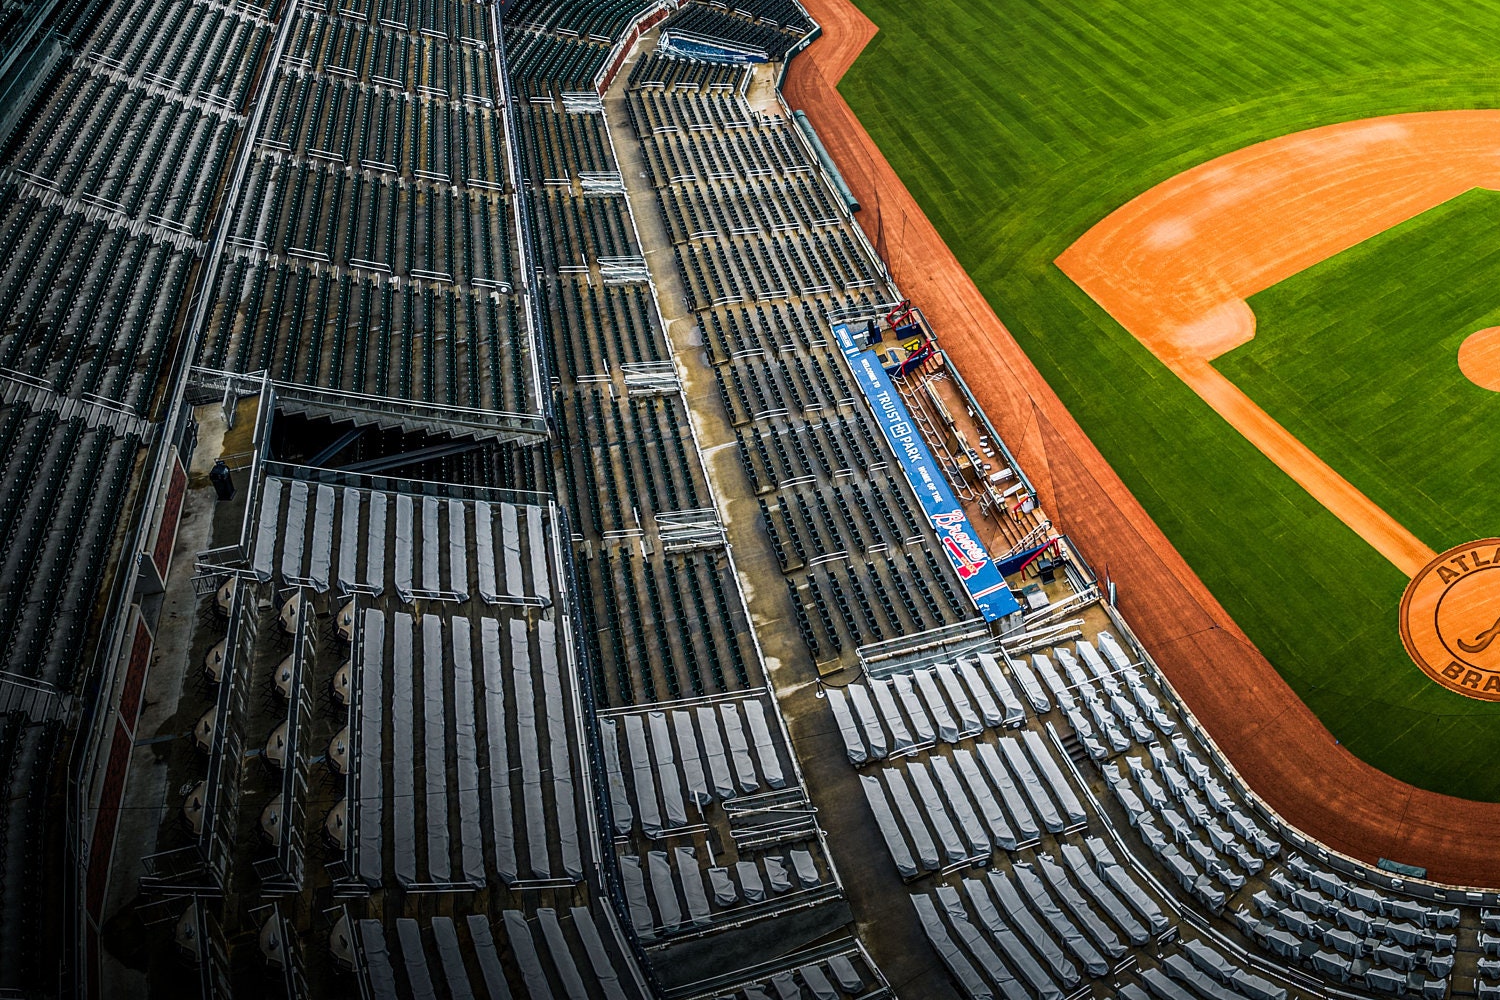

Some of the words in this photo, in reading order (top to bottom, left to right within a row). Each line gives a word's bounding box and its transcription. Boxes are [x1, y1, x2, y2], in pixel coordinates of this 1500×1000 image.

[861, 358, 877, 383] WELCOME
[873, 380, 880, 389] TO
[877, 391, 902, 424] TRUIST
[900, 434, 923, 465] PARK
[918, 465, 932, 484] HOME
[927, 480, 936, 491] OF
[931, 509, 989, 561] Braves
